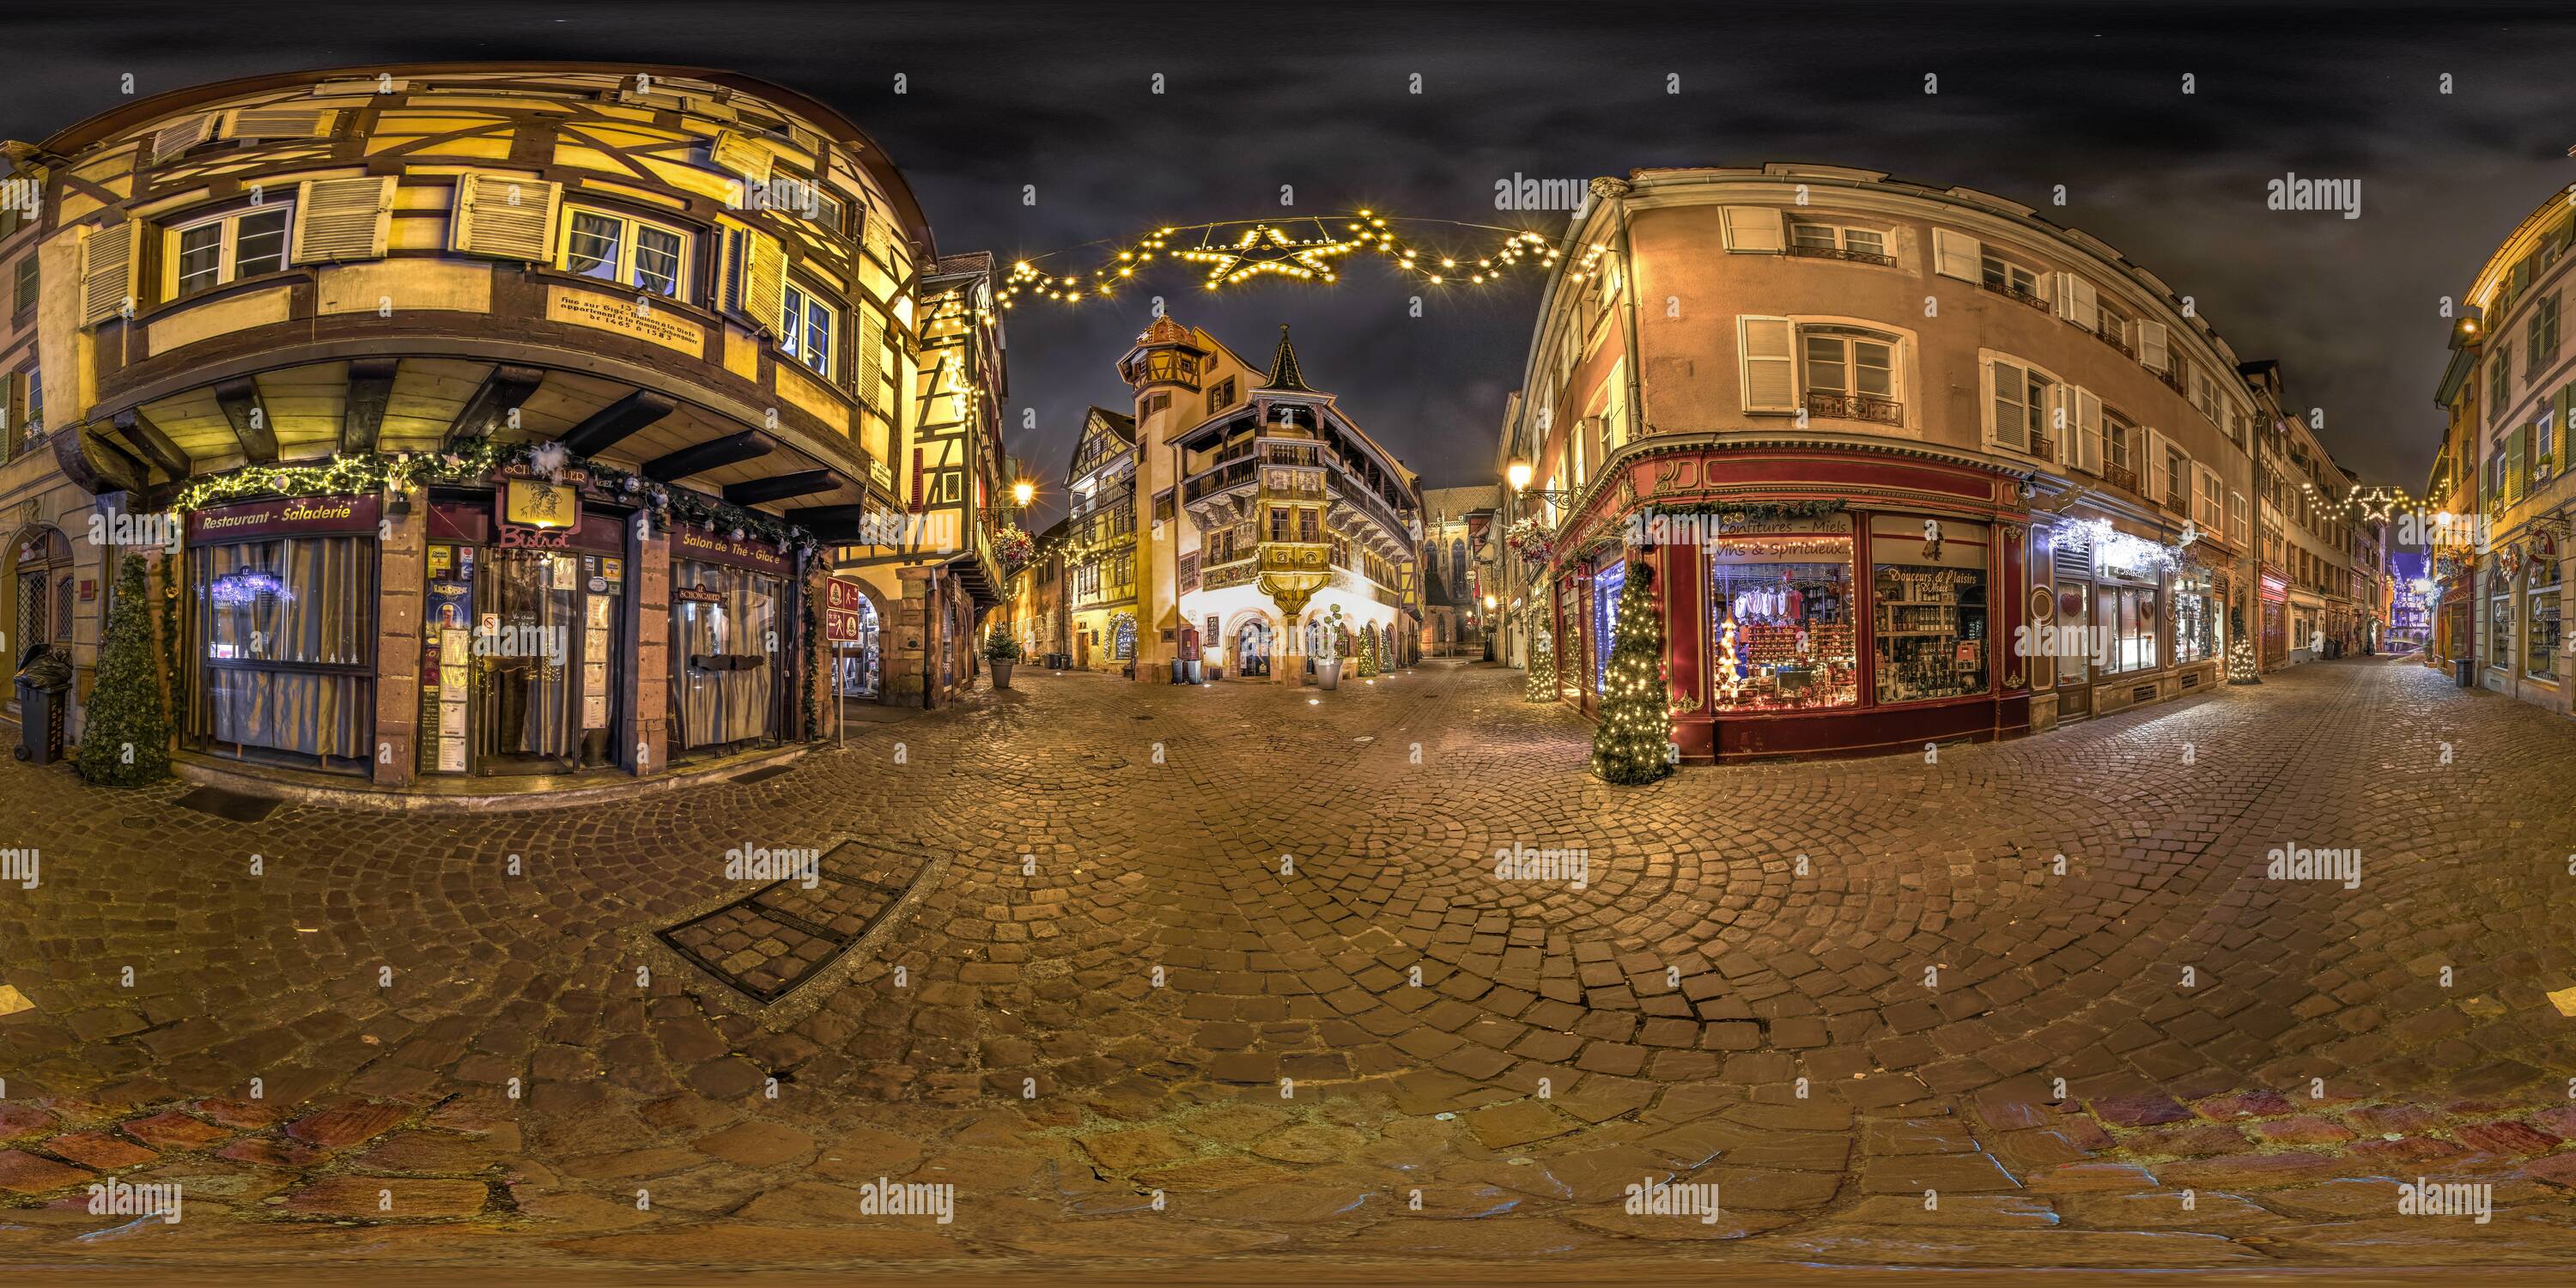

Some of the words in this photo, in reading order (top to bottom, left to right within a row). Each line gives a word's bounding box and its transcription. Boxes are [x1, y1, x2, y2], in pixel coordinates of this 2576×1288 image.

[605, 318, 630, 329] 1465
[203, 511, 270, 530] Restaurant
[281, 504, 351, 522] Saladerie
[1718, 517, 1793, 535] Confitures
[1812, 519, 1847, 533] Miels
[499, 524, 570, 549] Bistrot
[683, 533, 713, 550] Salon
[715, 540, 727, 552] de
[732, 543, 748, 556] Thé
[1716, 544, 1746, 557] Vins
[1752, 544, 1765, 556] &
[1888, 568, 1932, 583] Douceurs
[1935, 571, 1944, 583] &
[1946, 569, 1977, 584] Plaisirs
